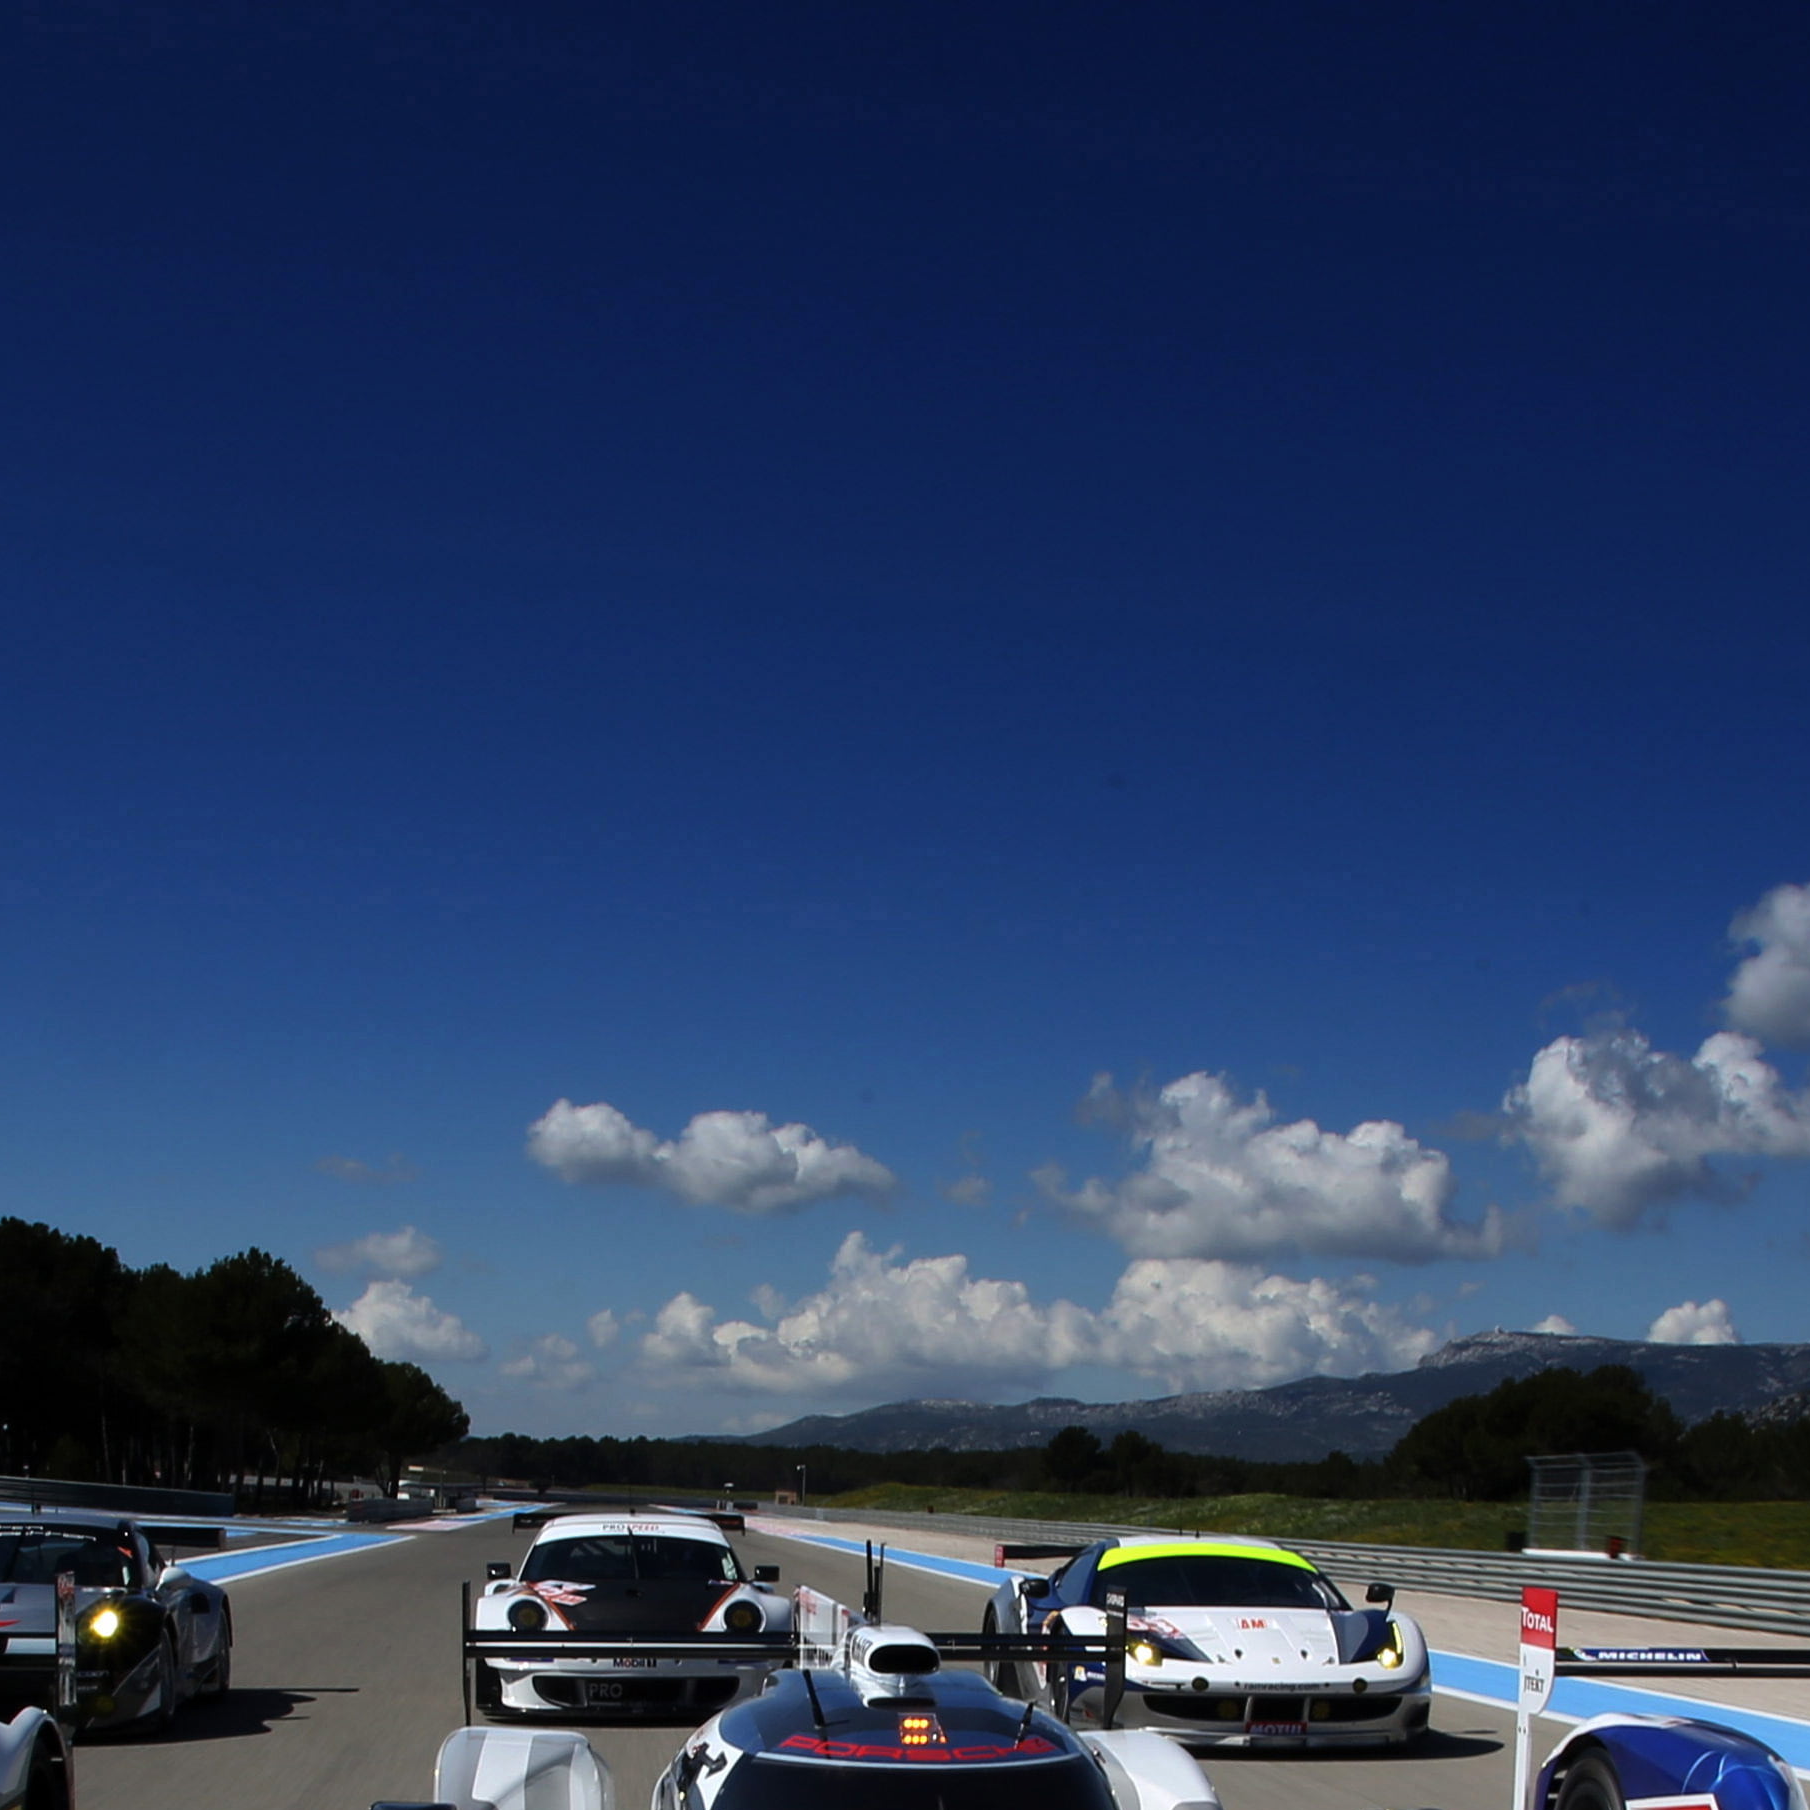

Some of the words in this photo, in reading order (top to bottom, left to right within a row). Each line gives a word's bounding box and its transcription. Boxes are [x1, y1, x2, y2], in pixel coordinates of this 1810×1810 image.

[1521, 1607, 1554, 1633] TOTAL
[1597, 1651, 1702, 1662] MICHELIN
[776, 1735, 1059, 1761] PORSCHE
